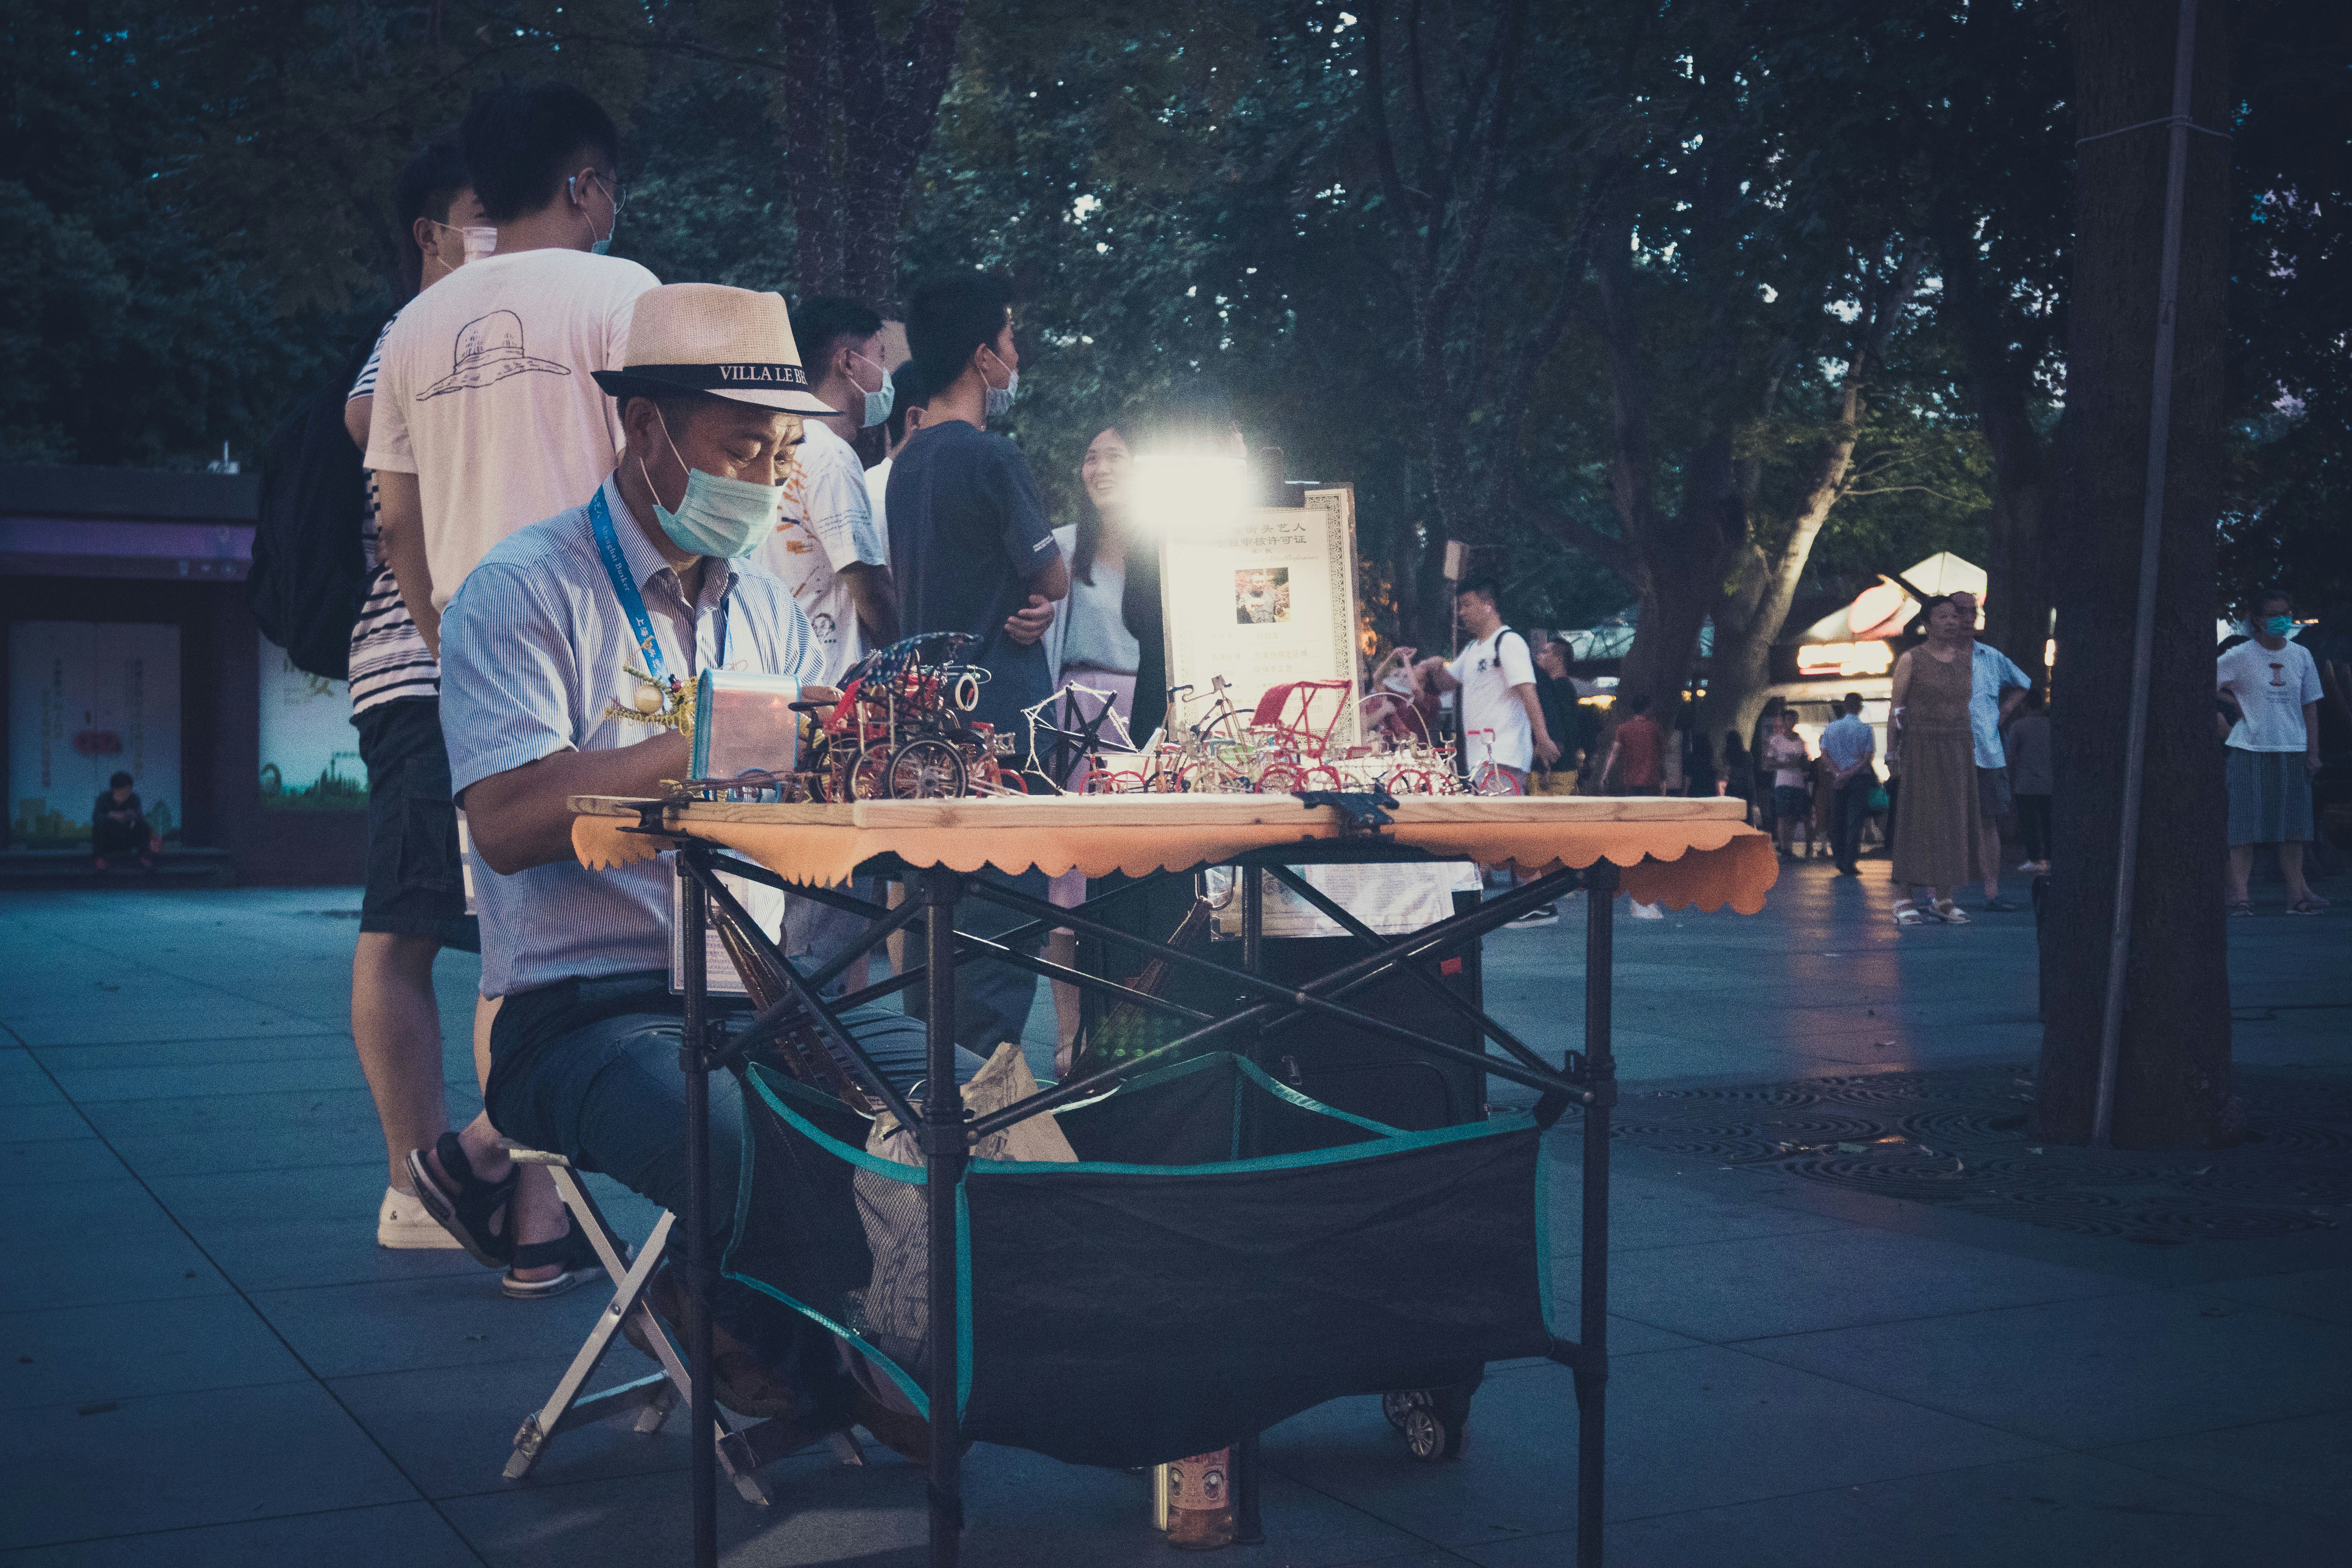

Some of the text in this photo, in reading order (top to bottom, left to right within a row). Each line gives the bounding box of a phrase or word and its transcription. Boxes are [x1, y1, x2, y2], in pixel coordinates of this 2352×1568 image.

[719, 366, 773, 381] VILLA
[775, 367, 793, 382] LE
[602, 525, 630, 591] Shanghai Busker
[1254, 649, 1308, 659] 市演协指定区域
[1254, 664, 1293, 673] 环保手工艺
